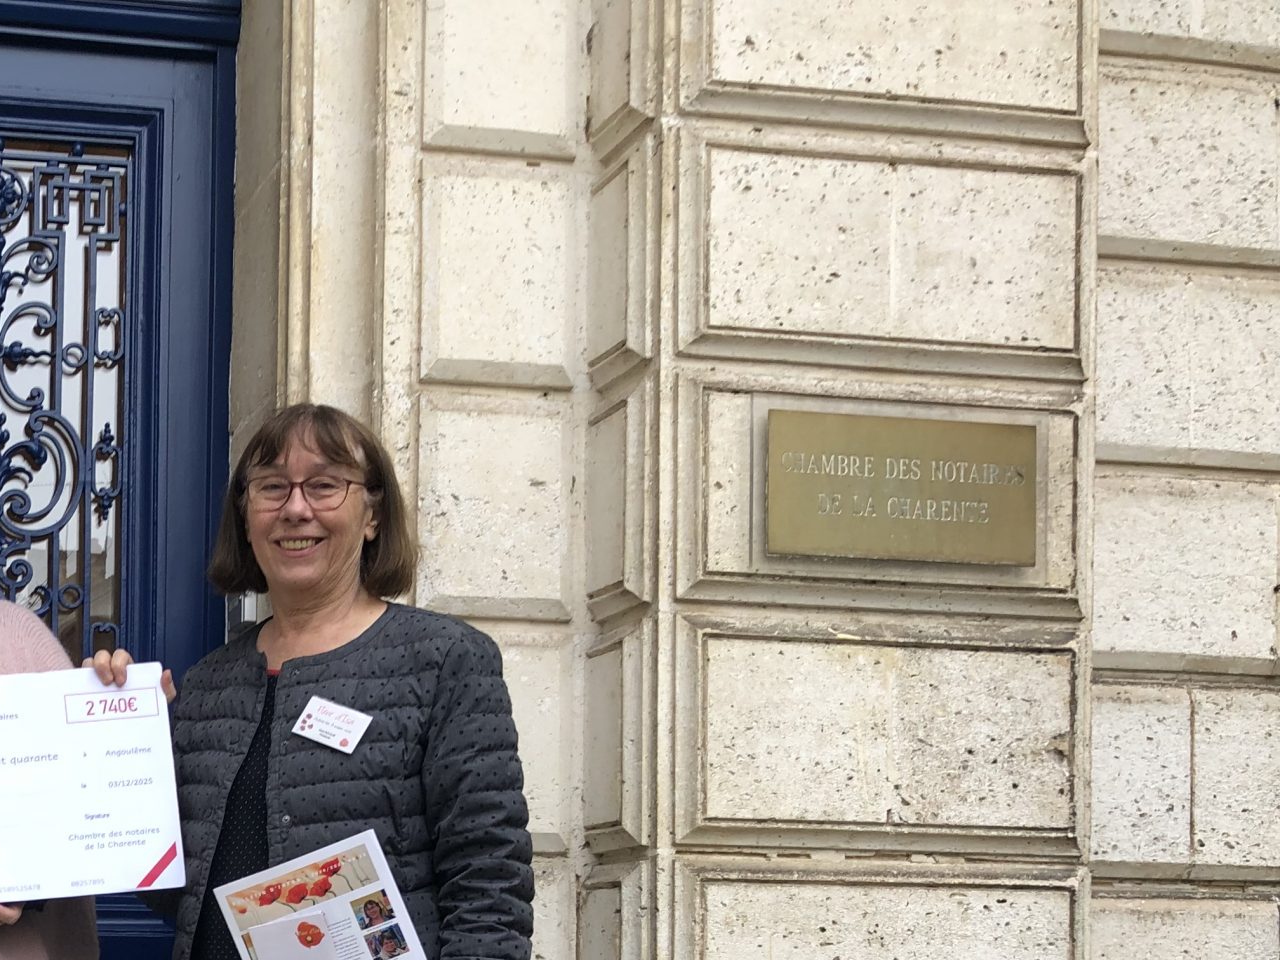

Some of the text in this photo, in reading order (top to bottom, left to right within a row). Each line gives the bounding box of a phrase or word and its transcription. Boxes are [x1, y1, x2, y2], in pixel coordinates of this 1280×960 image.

[782, 452, 1026, 486] CHAMBRE DES NOTAIRES
[818, 493, 991, 525] DE LA CHARENTE
[85, 696, 138, 716] 2 740€
[10, 753, 59, 766] quarante
[105, 747, 152, 758] Angoulême
[84, 813, 110, 821] Signature
[68, 827, 160, 842] Chambre des notaires
[84, 839, 146, 851] de la Charente
